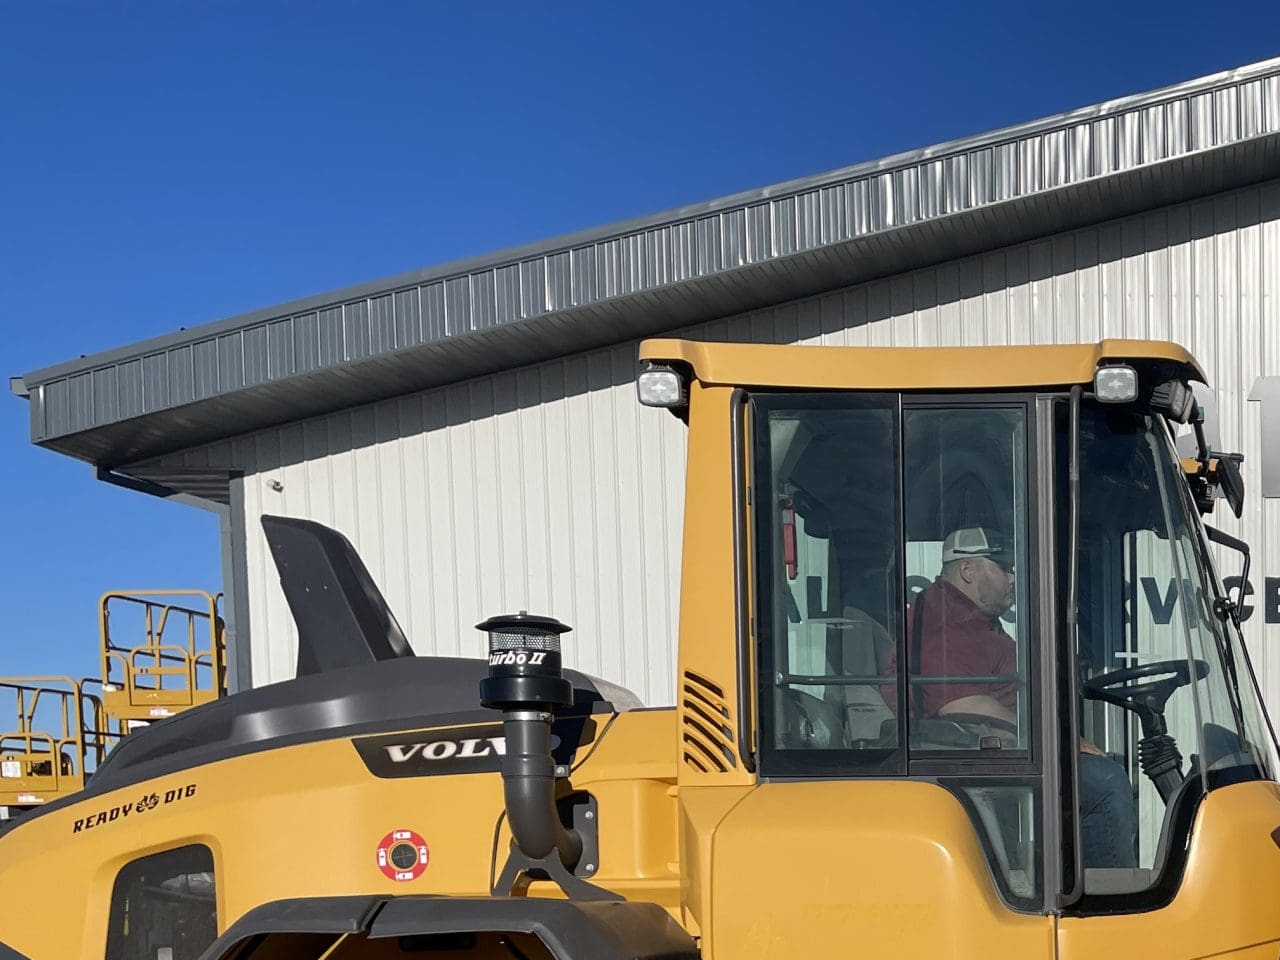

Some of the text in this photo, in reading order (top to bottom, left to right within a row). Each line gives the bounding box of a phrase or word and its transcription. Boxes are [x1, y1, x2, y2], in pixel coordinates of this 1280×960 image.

[385, 737, 507, 763] VOLV
[72, 784, 197, 833] READY DIG
